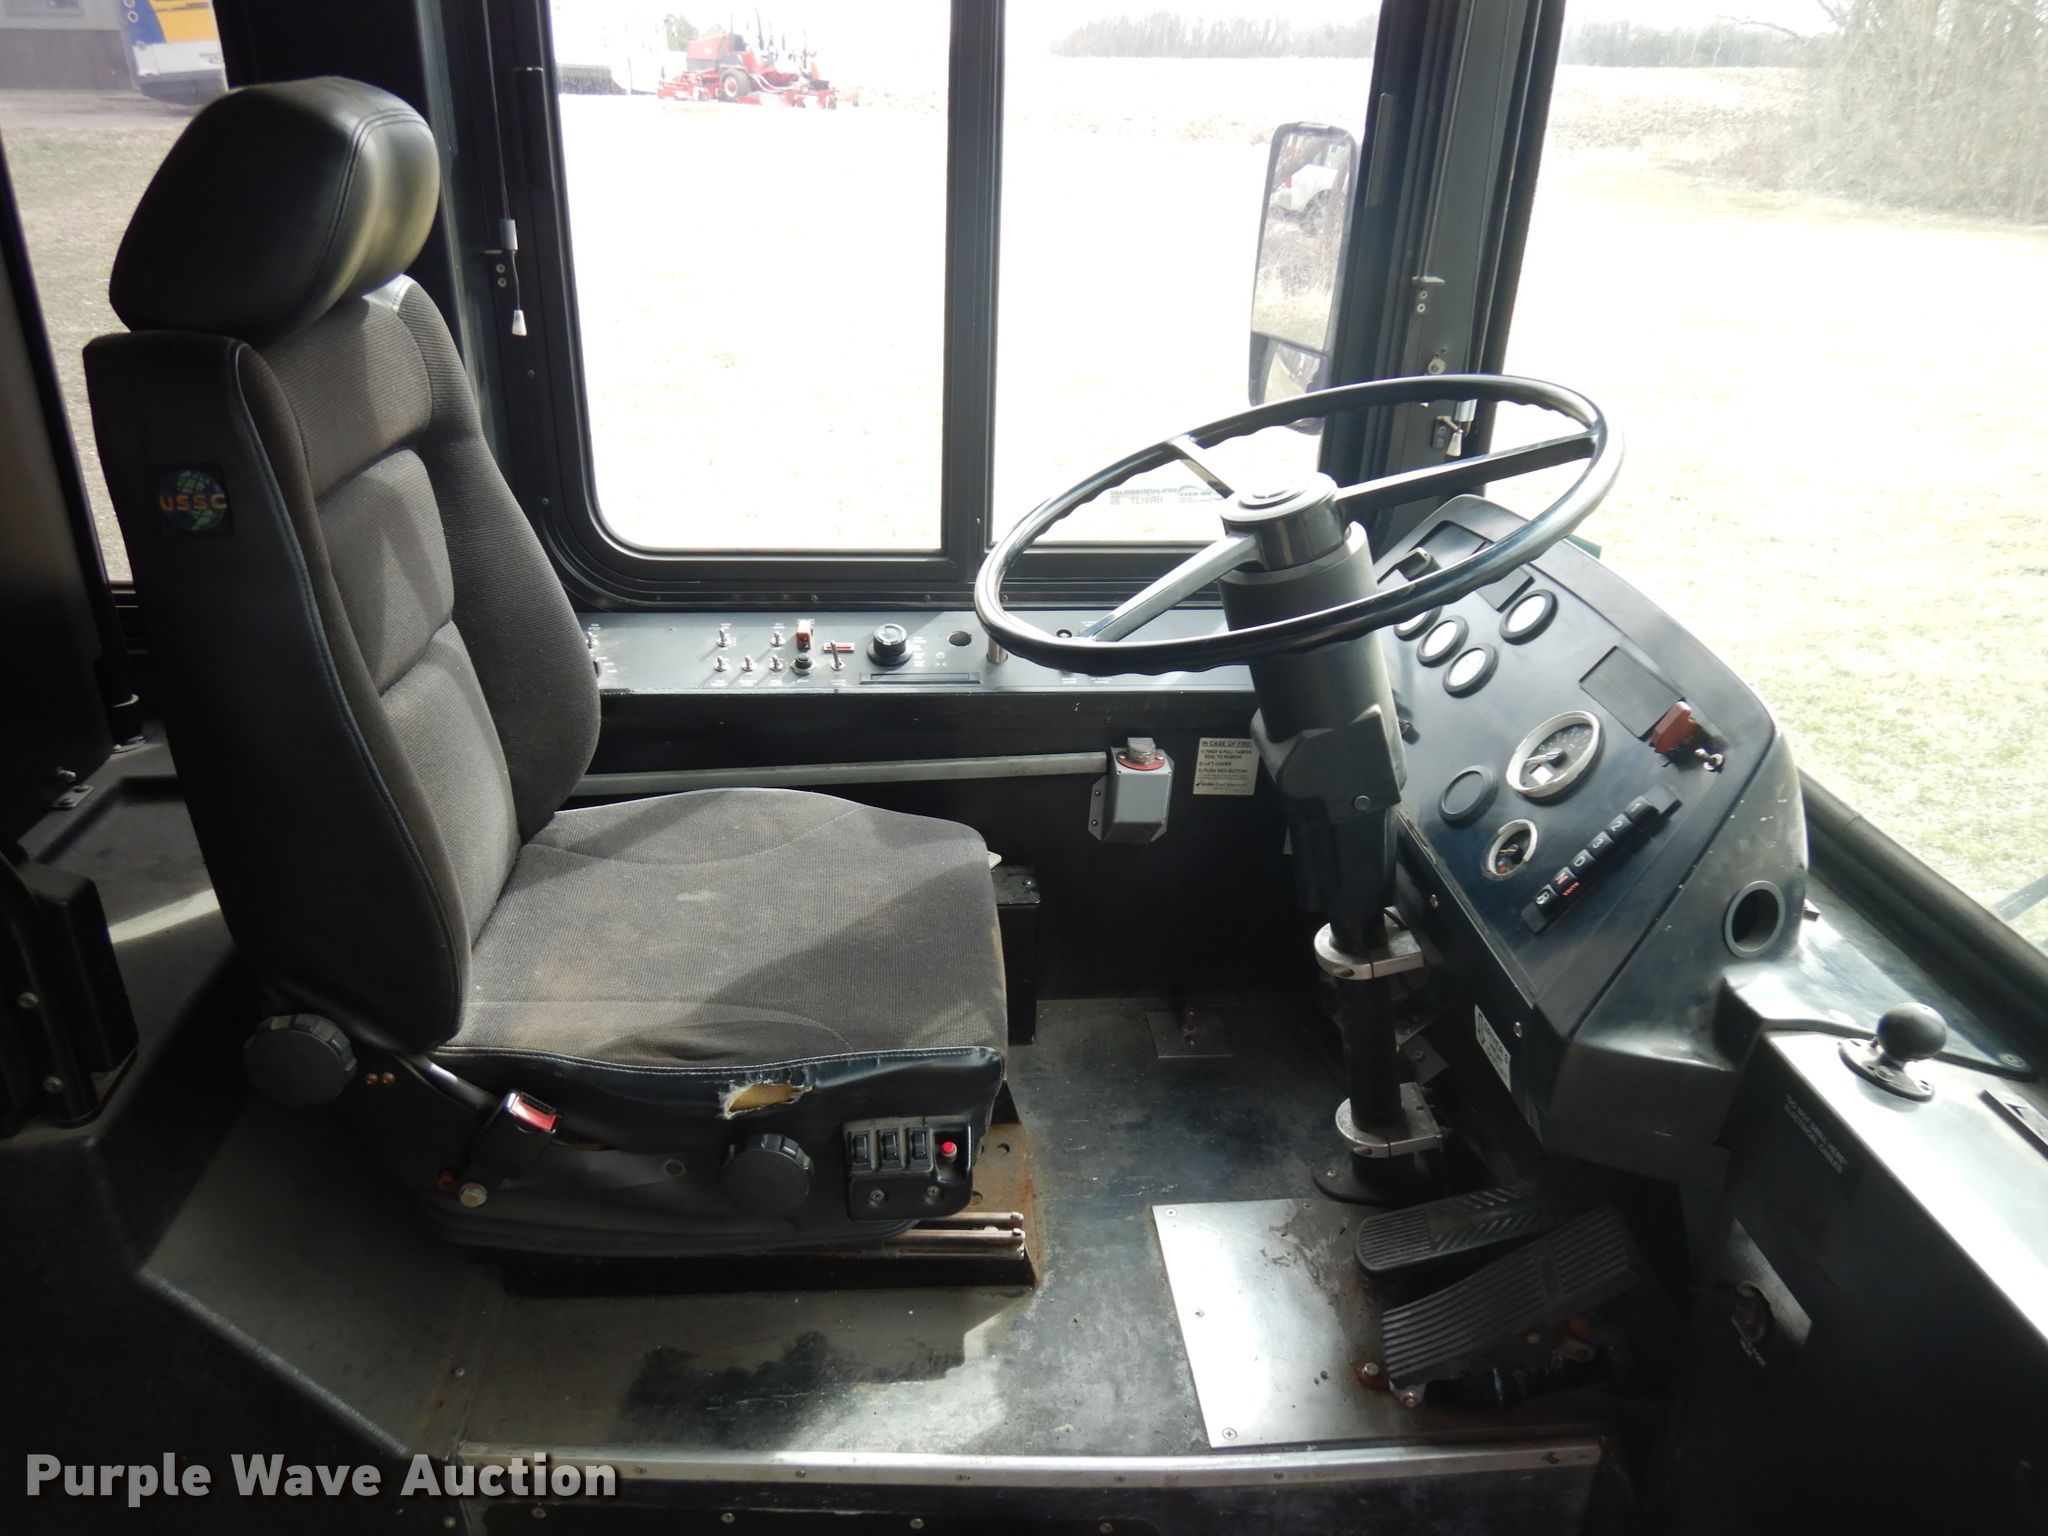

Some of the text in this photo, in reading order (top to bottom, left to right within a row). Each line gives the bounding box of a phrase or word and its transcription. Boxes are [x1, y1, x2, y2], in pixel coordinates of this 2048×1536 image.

[159, 492, 228, 512] USSC
[1629, 802, 1641, 813] 1
[1611, 820, 1622, 831] 2
[1592, 838, 1603, 849] 3
[1574, 856, 1586, 867] D
[1554, 873, 1568, 885] N
[1536, 892, 1550, 905] R
